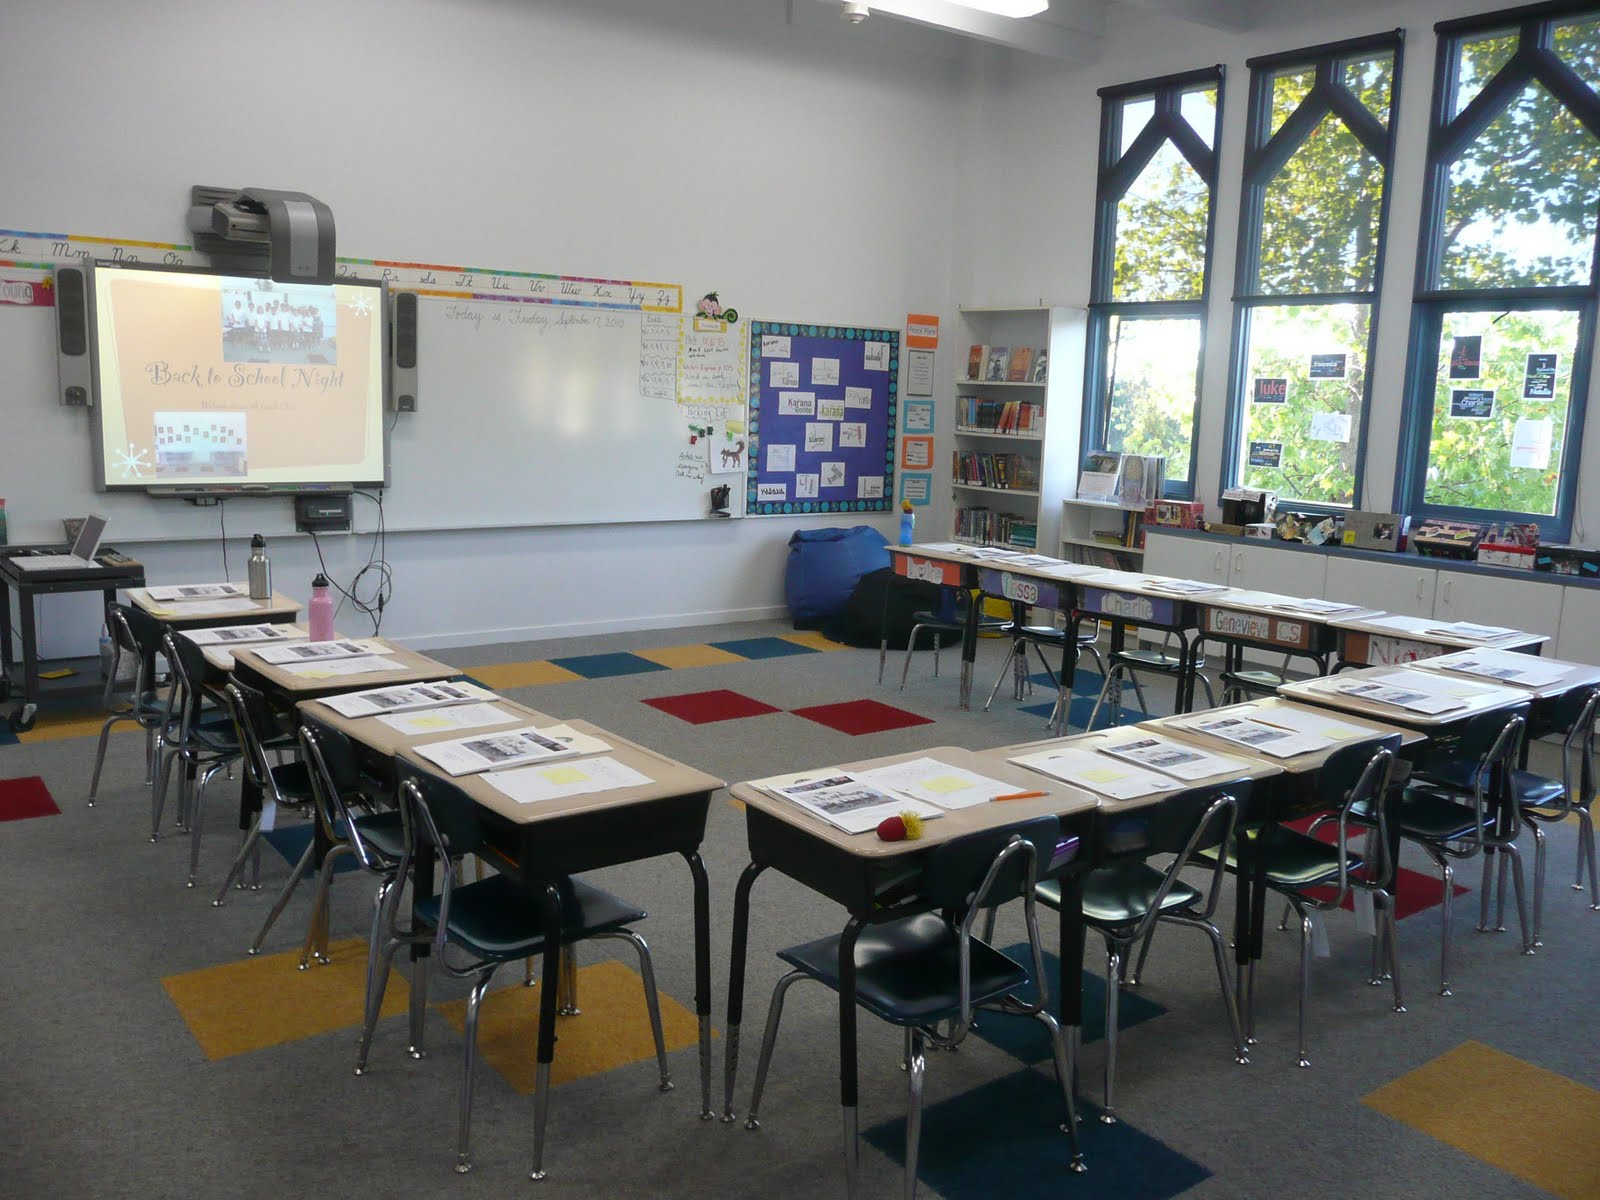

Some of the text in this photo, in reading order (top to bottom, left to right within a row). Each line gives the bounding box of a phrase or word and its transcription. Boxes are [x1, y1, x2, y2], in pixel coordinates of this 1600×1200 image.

[0, 282, 32, 302] oung
[445, 305, 483, 332] Today
[492, 311, 501, 322] is
[604, 317, 625, 329] 2010
[145, 360, 345, 393] Back to School Night
[1260, 380, 1286, 395] luke
[788, 398, 812, 408] Karana
[1003, 573, 1037, 602] Tessa
[1103, 594, 1153, 619] Charlie
[1215, 609, 1269, 639] Genevieve
